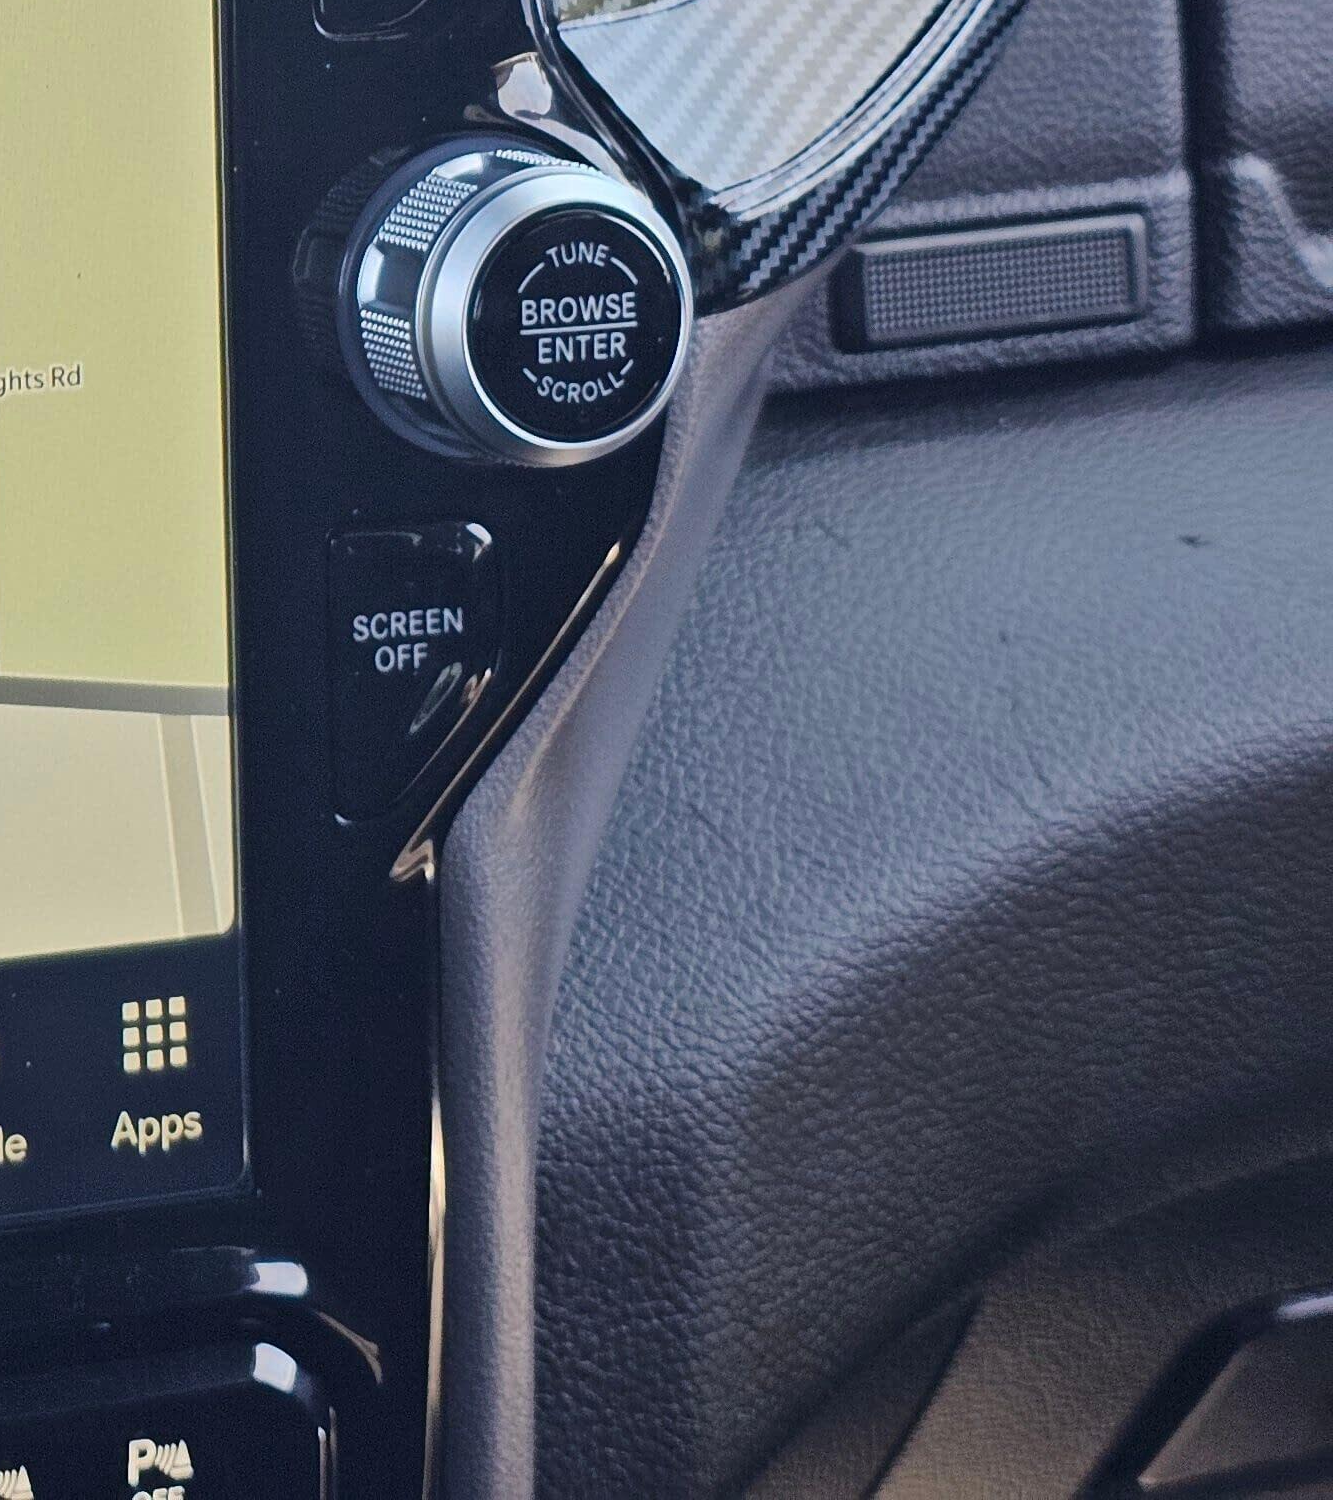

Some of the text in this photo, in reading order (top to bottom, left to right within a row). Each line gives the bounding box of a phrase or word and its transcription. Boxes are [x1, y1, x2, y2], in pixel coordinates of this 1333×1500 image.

[545, 241, 609, 268] TUNE
[521, 291, 638, 327] BROWSE
[537, 332, 626, 365] ENTER
[51, 364, 81, 388] Rd
[536, 372, 625, 404] SCROLL
[352, 607, 464, 643] SCREEN
[374, 642, 428, 673] OFF
[110, 1110, 203, 1155] Apps
